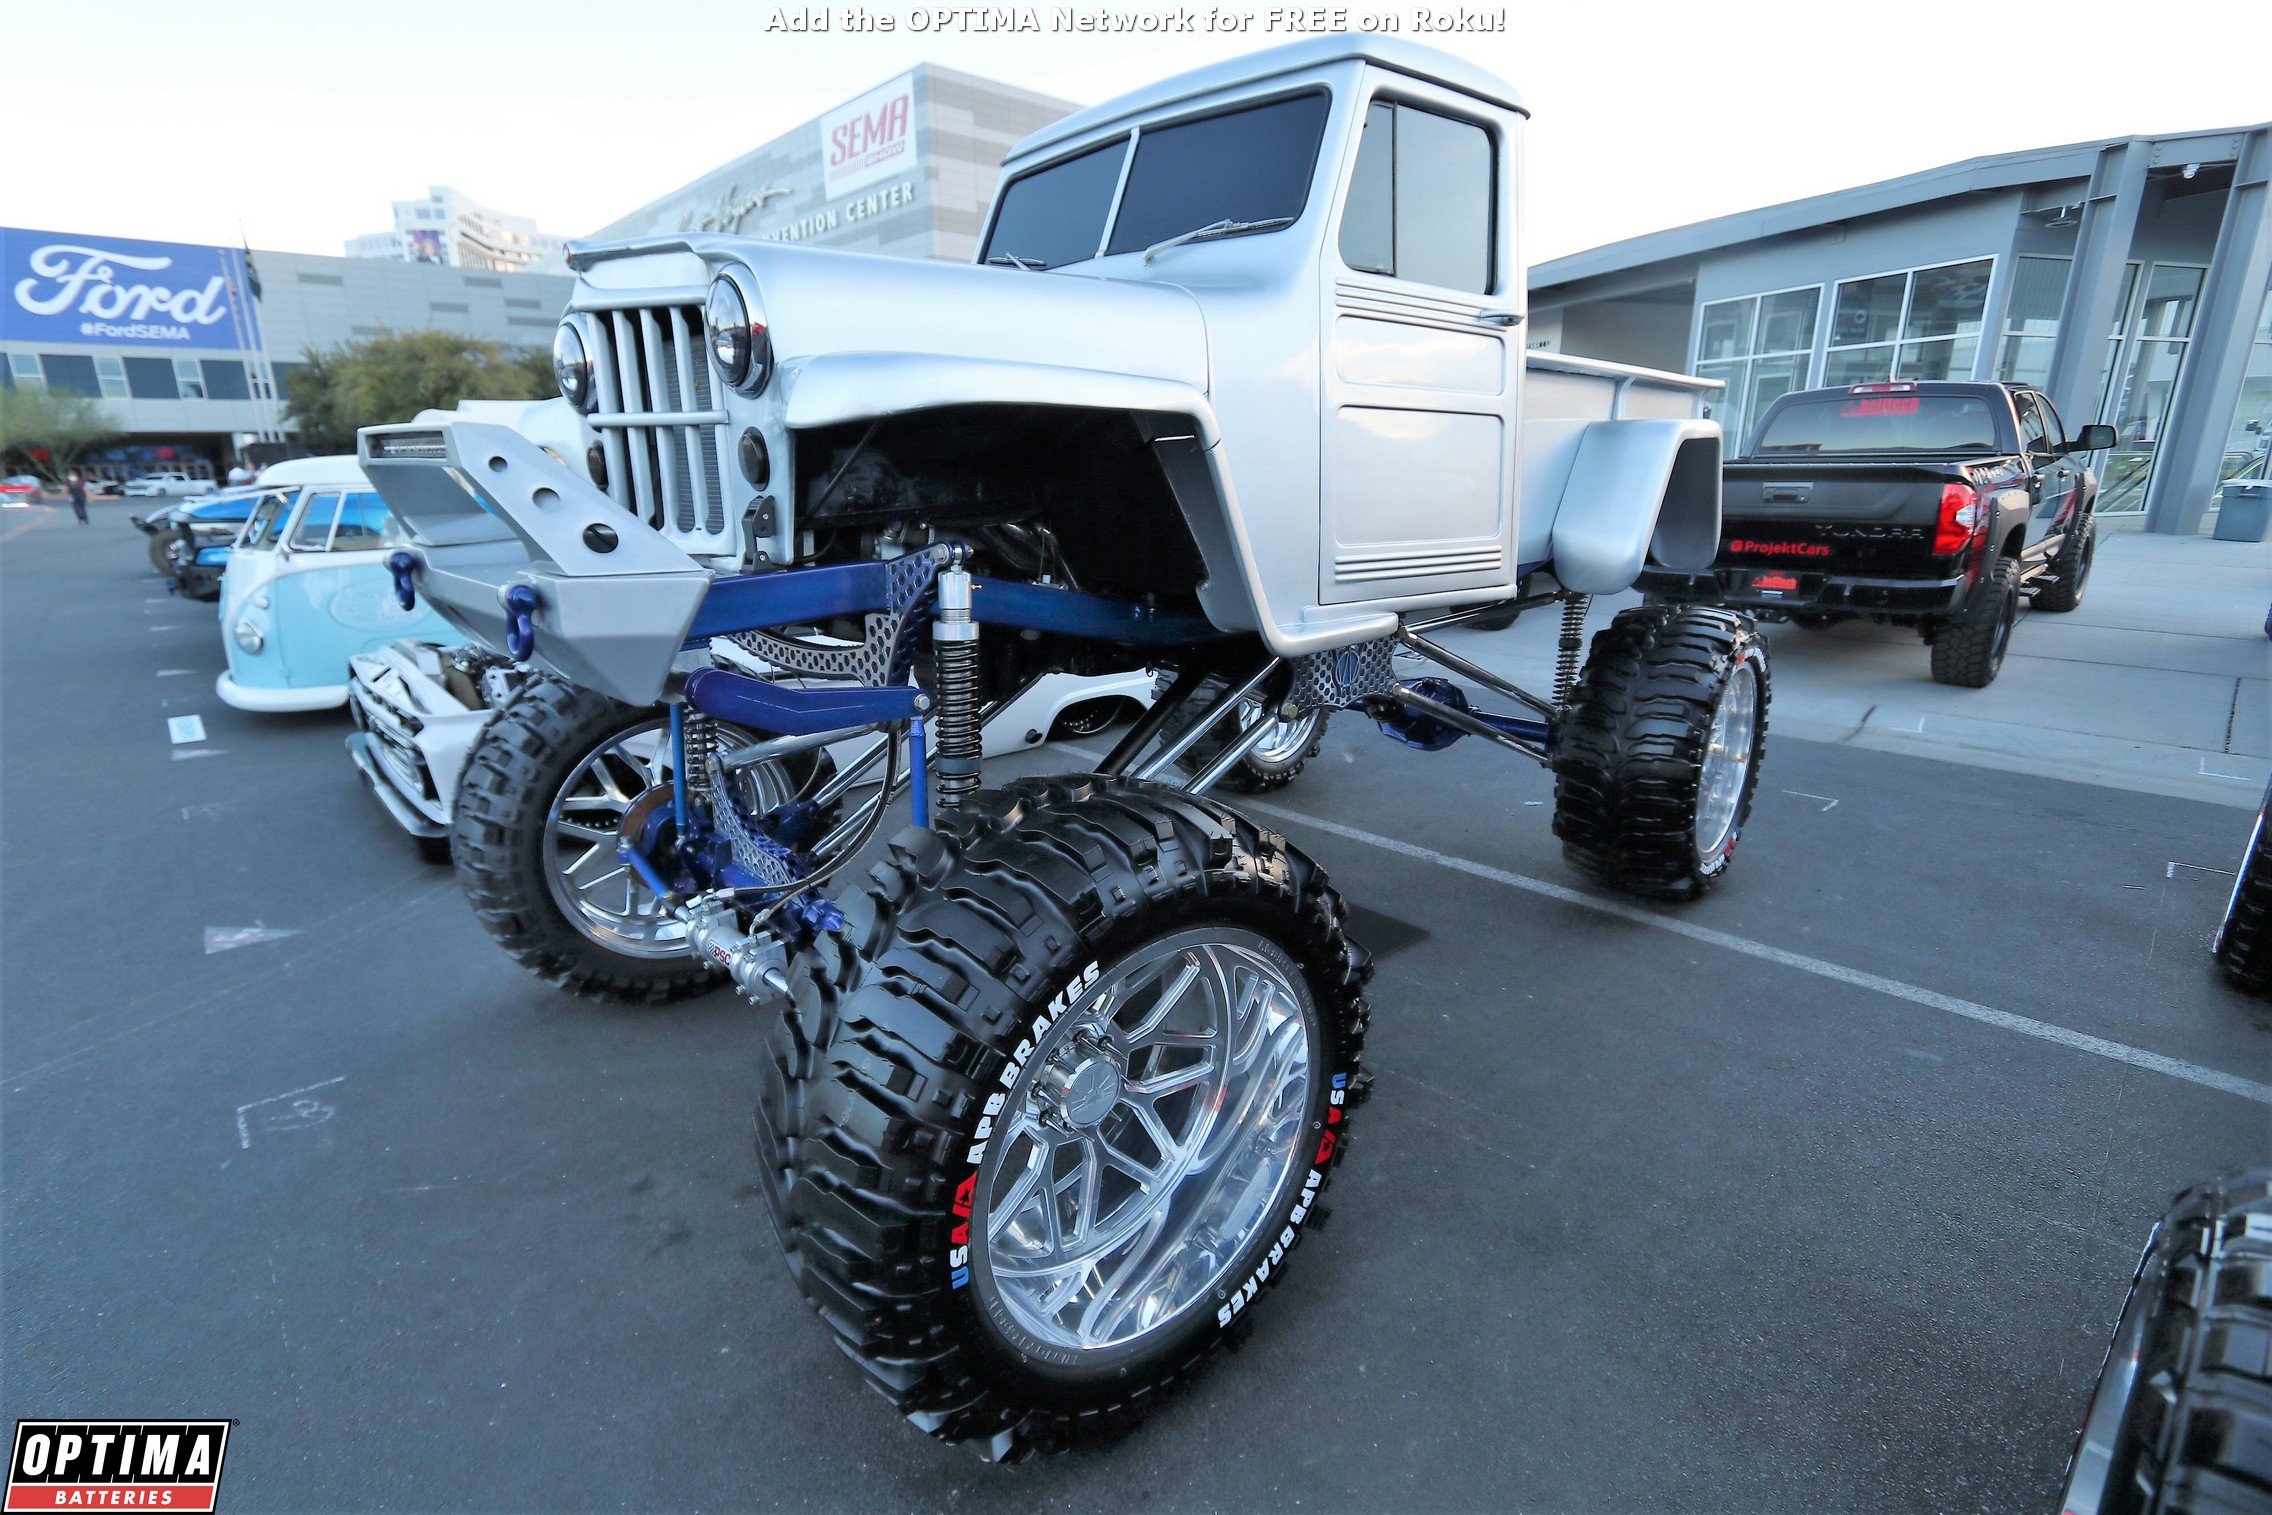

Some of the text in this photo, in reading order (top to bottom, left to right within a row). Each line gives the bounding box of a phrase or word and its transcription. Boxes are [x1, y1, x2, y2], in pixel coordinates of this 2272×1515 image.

[829, 93, 909, 167] SEMA
[846, 181, 913, 222] CENTER
[14, 244, 226, 325] Ford
[79, 322, 191, 341] #FordSEMA
[1744, 540, 1830, 556] ProjektCars
[950, 960, 1100, 1290] USA APB BRAKES
[1217, 1072, 1347, 1329] USA APB BRAKES
